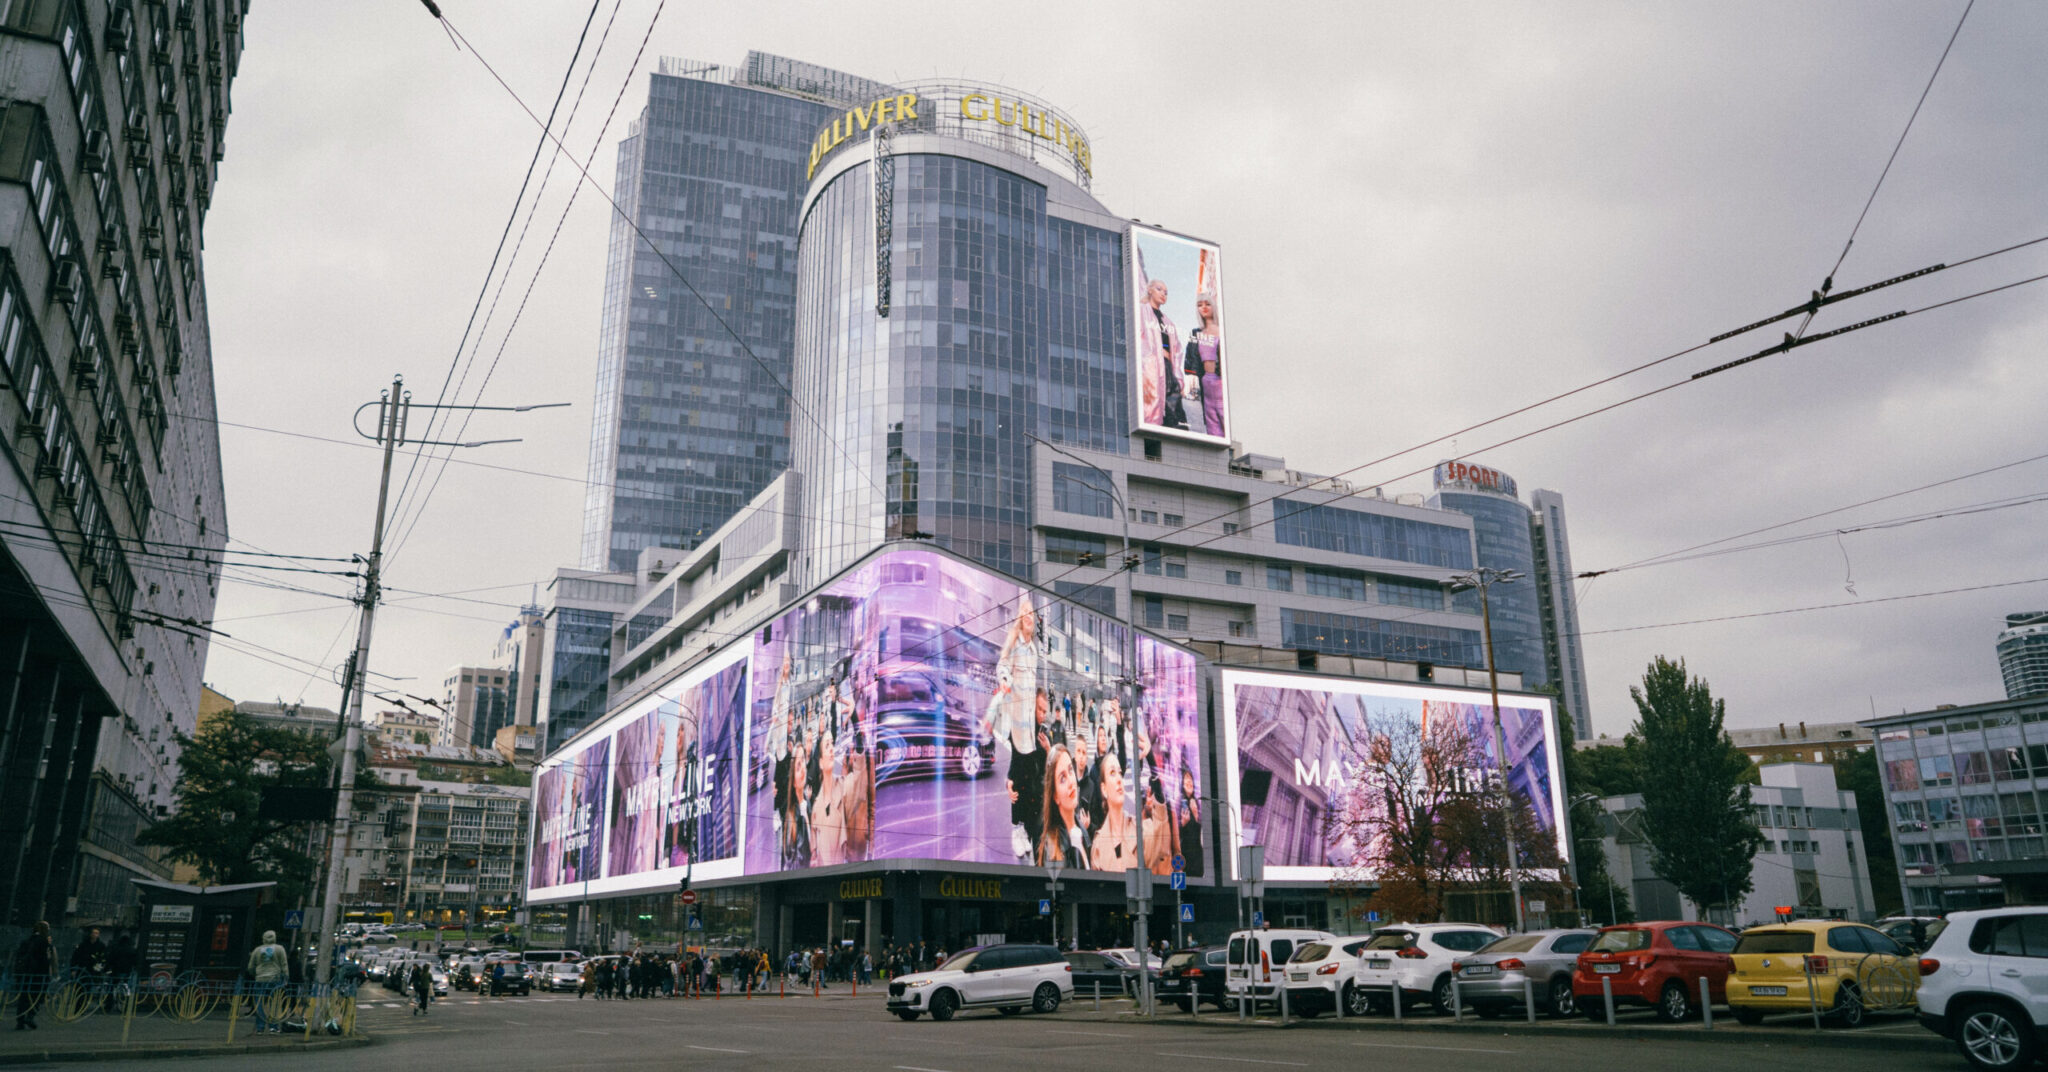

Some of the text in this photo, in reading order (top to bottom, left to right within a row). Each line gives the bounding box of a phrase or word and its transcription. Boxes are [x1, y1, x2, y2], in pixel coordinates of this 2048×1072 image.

[807, 93, 918, 180] GULLIVER
[961, 93, 1093, 179] GULLIVER
[1448, 461, 1499, 489] SPORT
[625, 753, 717, 818] MAYBELLINE
[668, 801, 688, 825] NEW
[840, 878, 882, 899] GULLIVER
[940, 878, 1002, 898] GULLIVER
